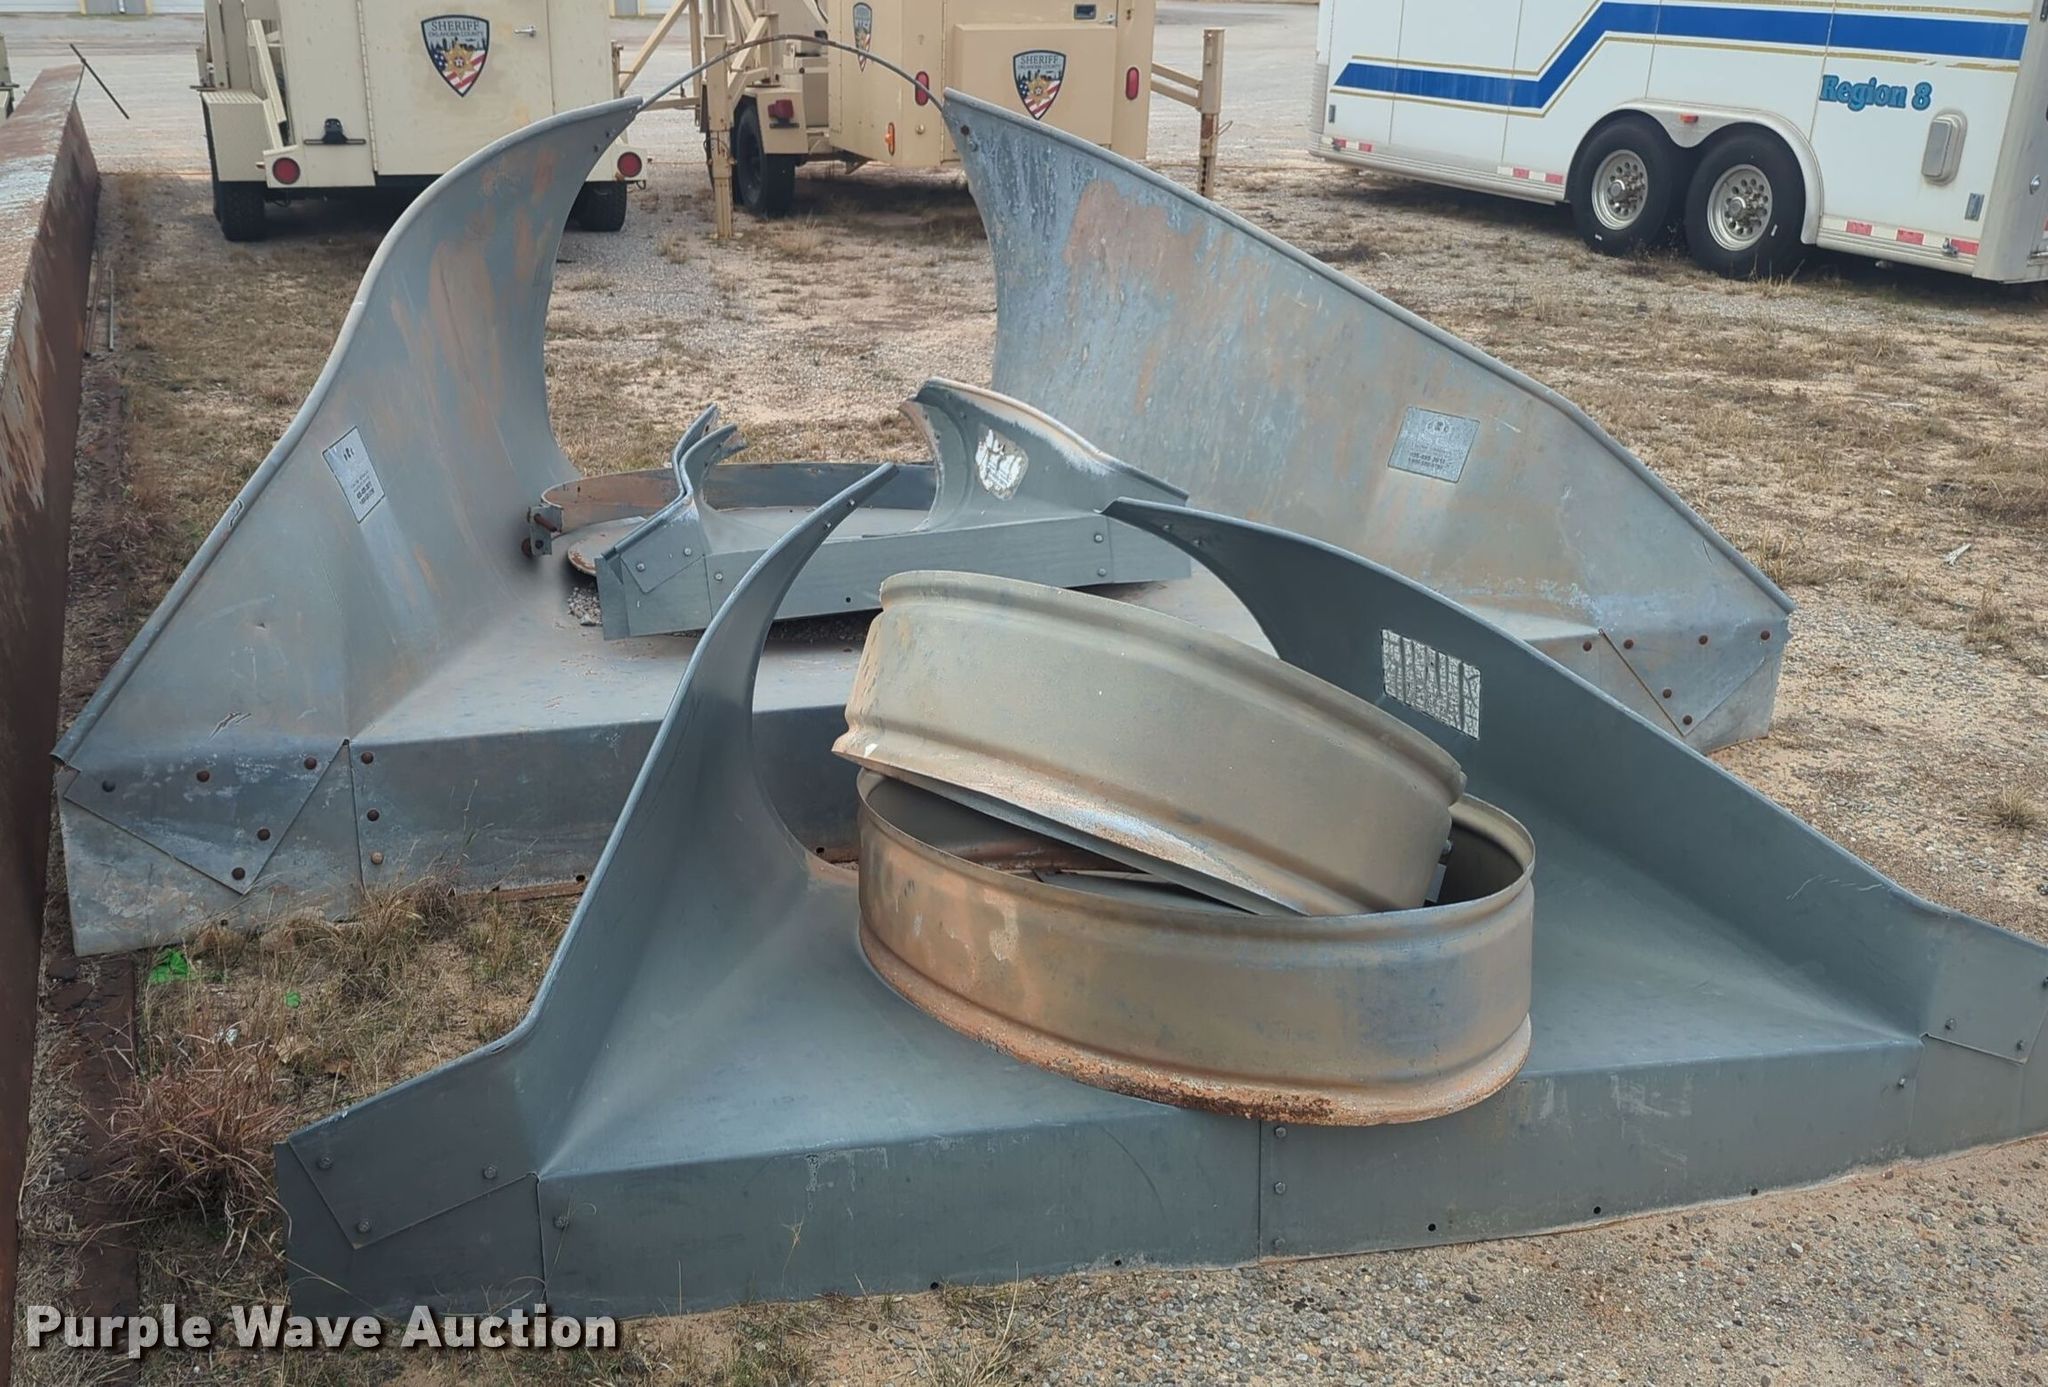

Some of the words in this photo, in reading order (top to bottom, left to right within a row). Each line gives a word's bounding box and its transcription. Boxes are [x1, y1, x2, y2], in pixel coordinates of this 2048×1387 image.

[431, 20, 480, 31] SHERIFF
[1020, 55, 1059, 64] SHERIFF
[1819, 74, 1908, 112] Region
[1911, 82, 1933, 111] 8
